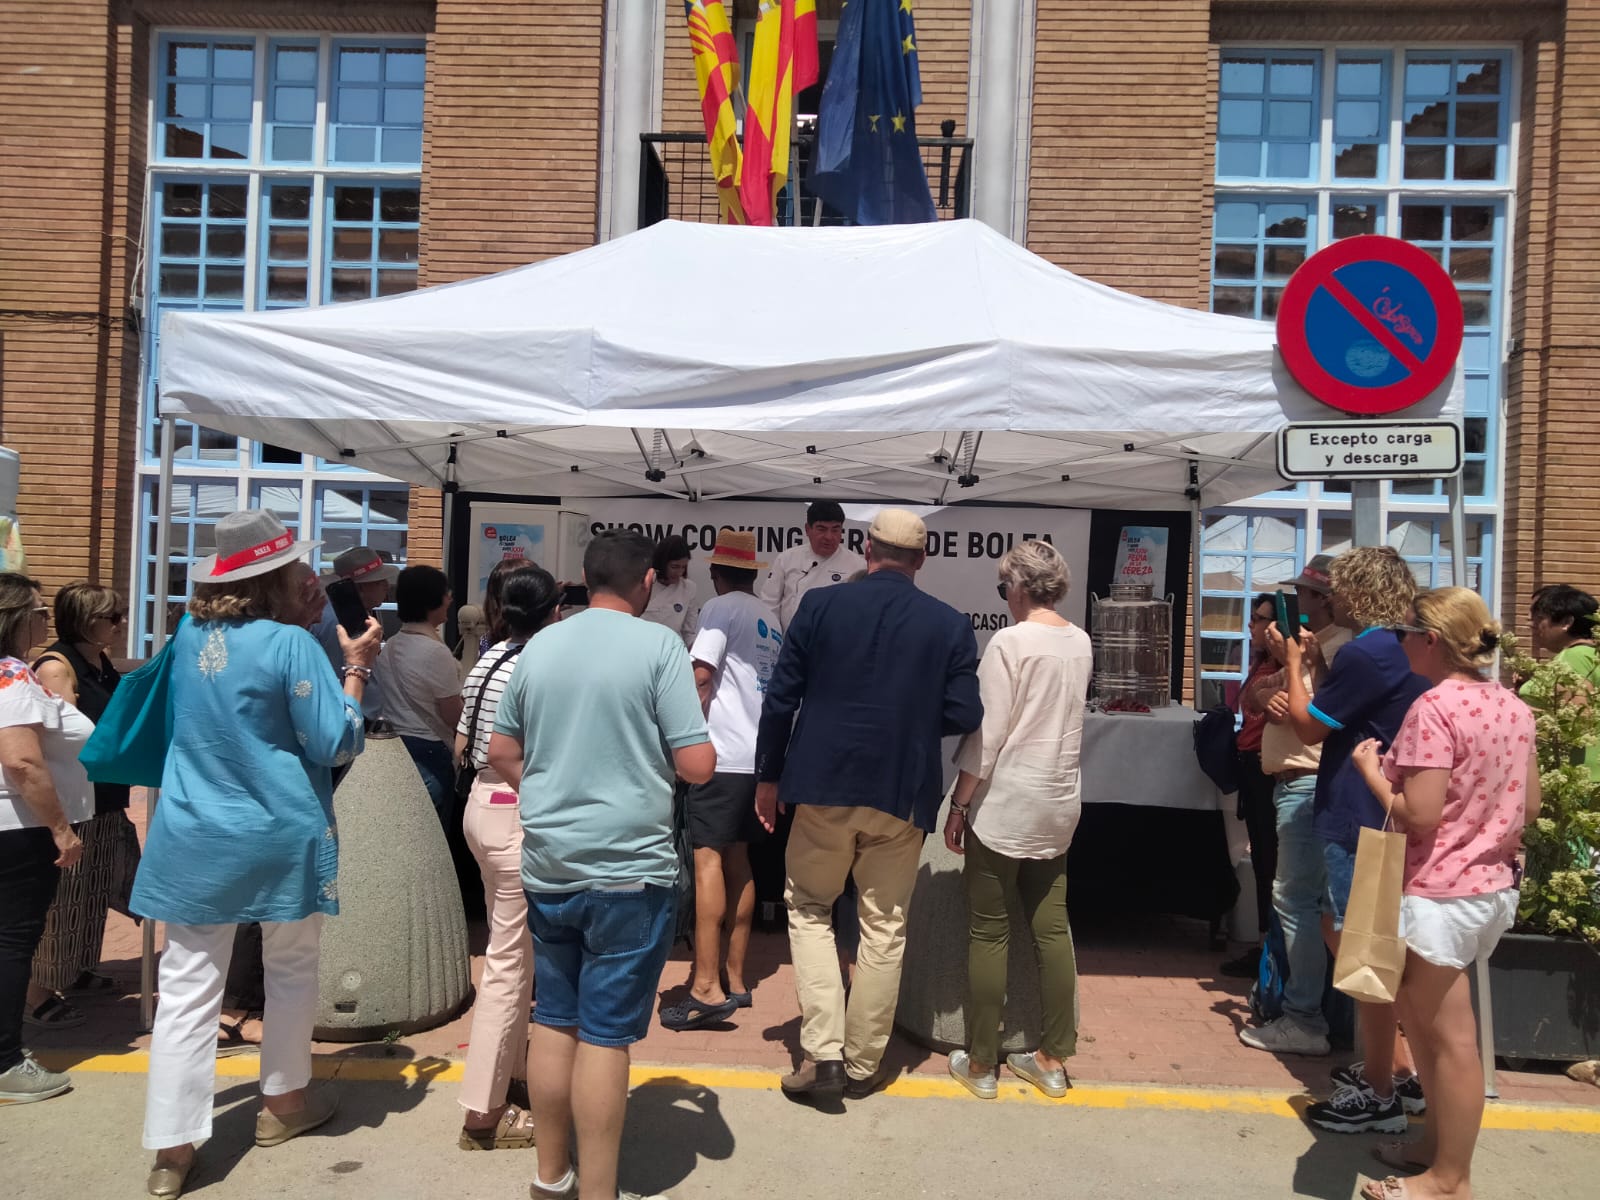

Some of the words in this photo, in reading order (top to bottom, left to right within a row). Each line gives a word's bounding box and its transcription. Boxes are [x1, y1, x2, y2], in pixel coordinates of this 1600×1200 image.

[1309, 432, 1378, 447] Excepto
[1386, 433, 1432, 446] carga
[1325, 455, 1334, 467] y
[1343, 452, 1419, 465] descarga
[590, 521, 673, 545] SW
[681, 524, 803, 553] COING
[925, 531, 958, 558] DE
[1122, 566, 1152, 575] CEREZA
[966, 612, 1008, 631] CASO
